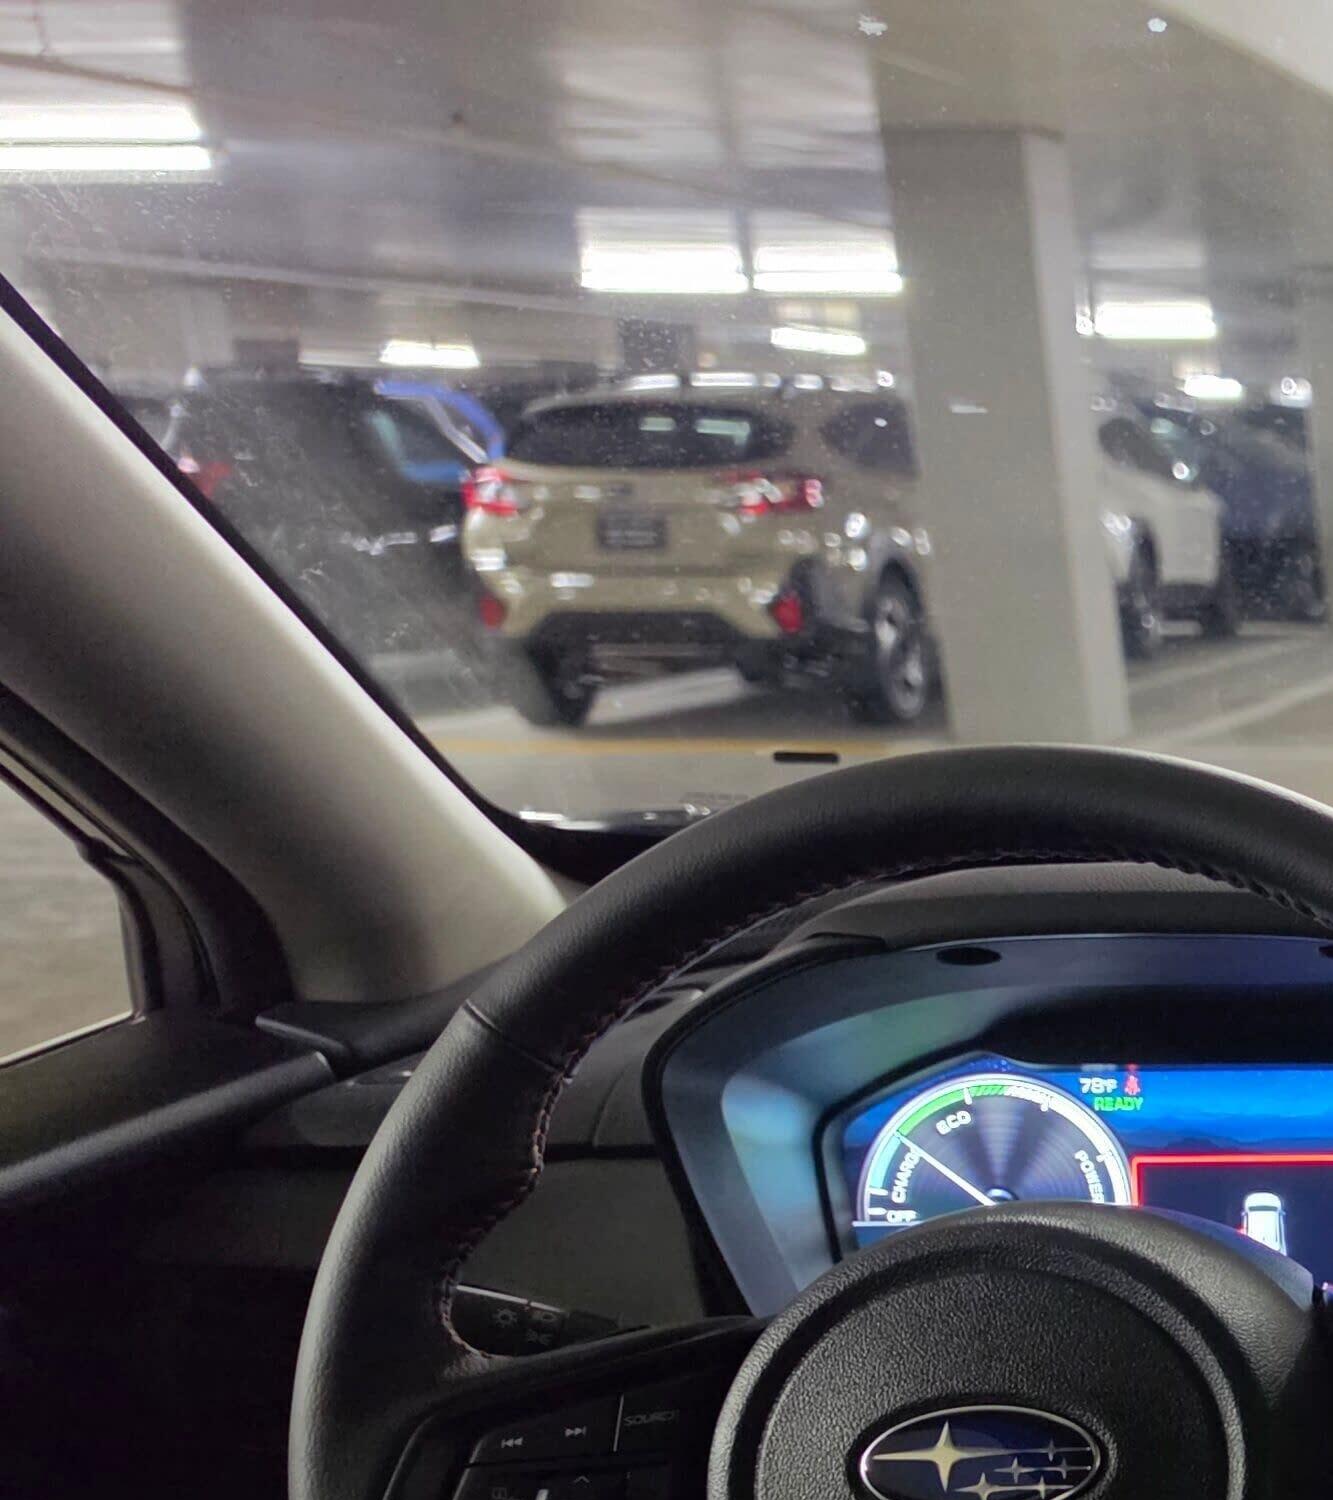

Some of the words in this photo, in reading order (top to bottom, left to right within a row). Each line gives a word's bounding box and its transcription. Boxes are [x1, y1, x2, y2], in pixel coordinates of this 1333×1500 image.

[1092, 1096, 1144, 1112] READY
[935, 1110, 972, 1135] ECO
[886, 1209, 918, 1223] OFF
